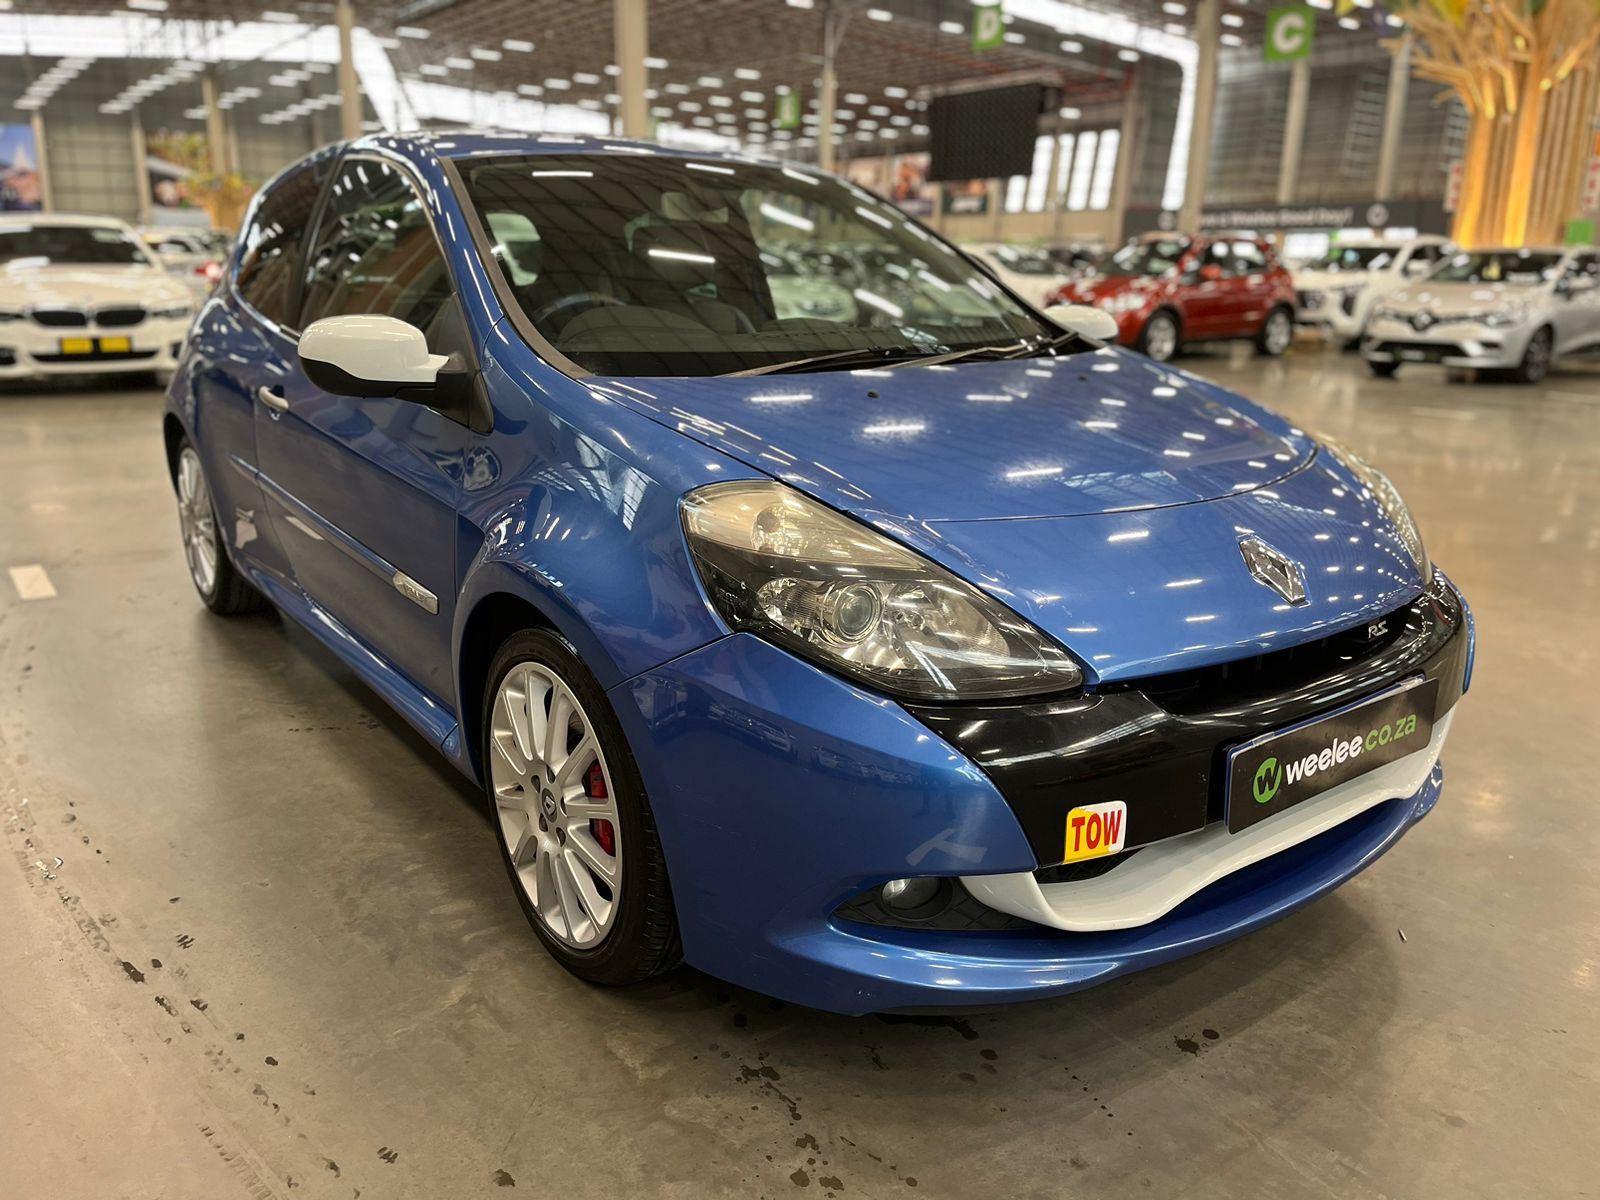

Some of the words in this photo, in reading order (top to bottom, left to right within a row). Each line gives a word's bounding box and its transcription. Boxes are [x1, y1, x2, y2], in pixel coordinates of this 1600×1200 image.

[979, 10, 1000, 42] D
[1273, 13, 1304, 53] C
[1286, 713, 1417, 785] weelee.co.za
[1072, 809, 1122, 852] TOW
